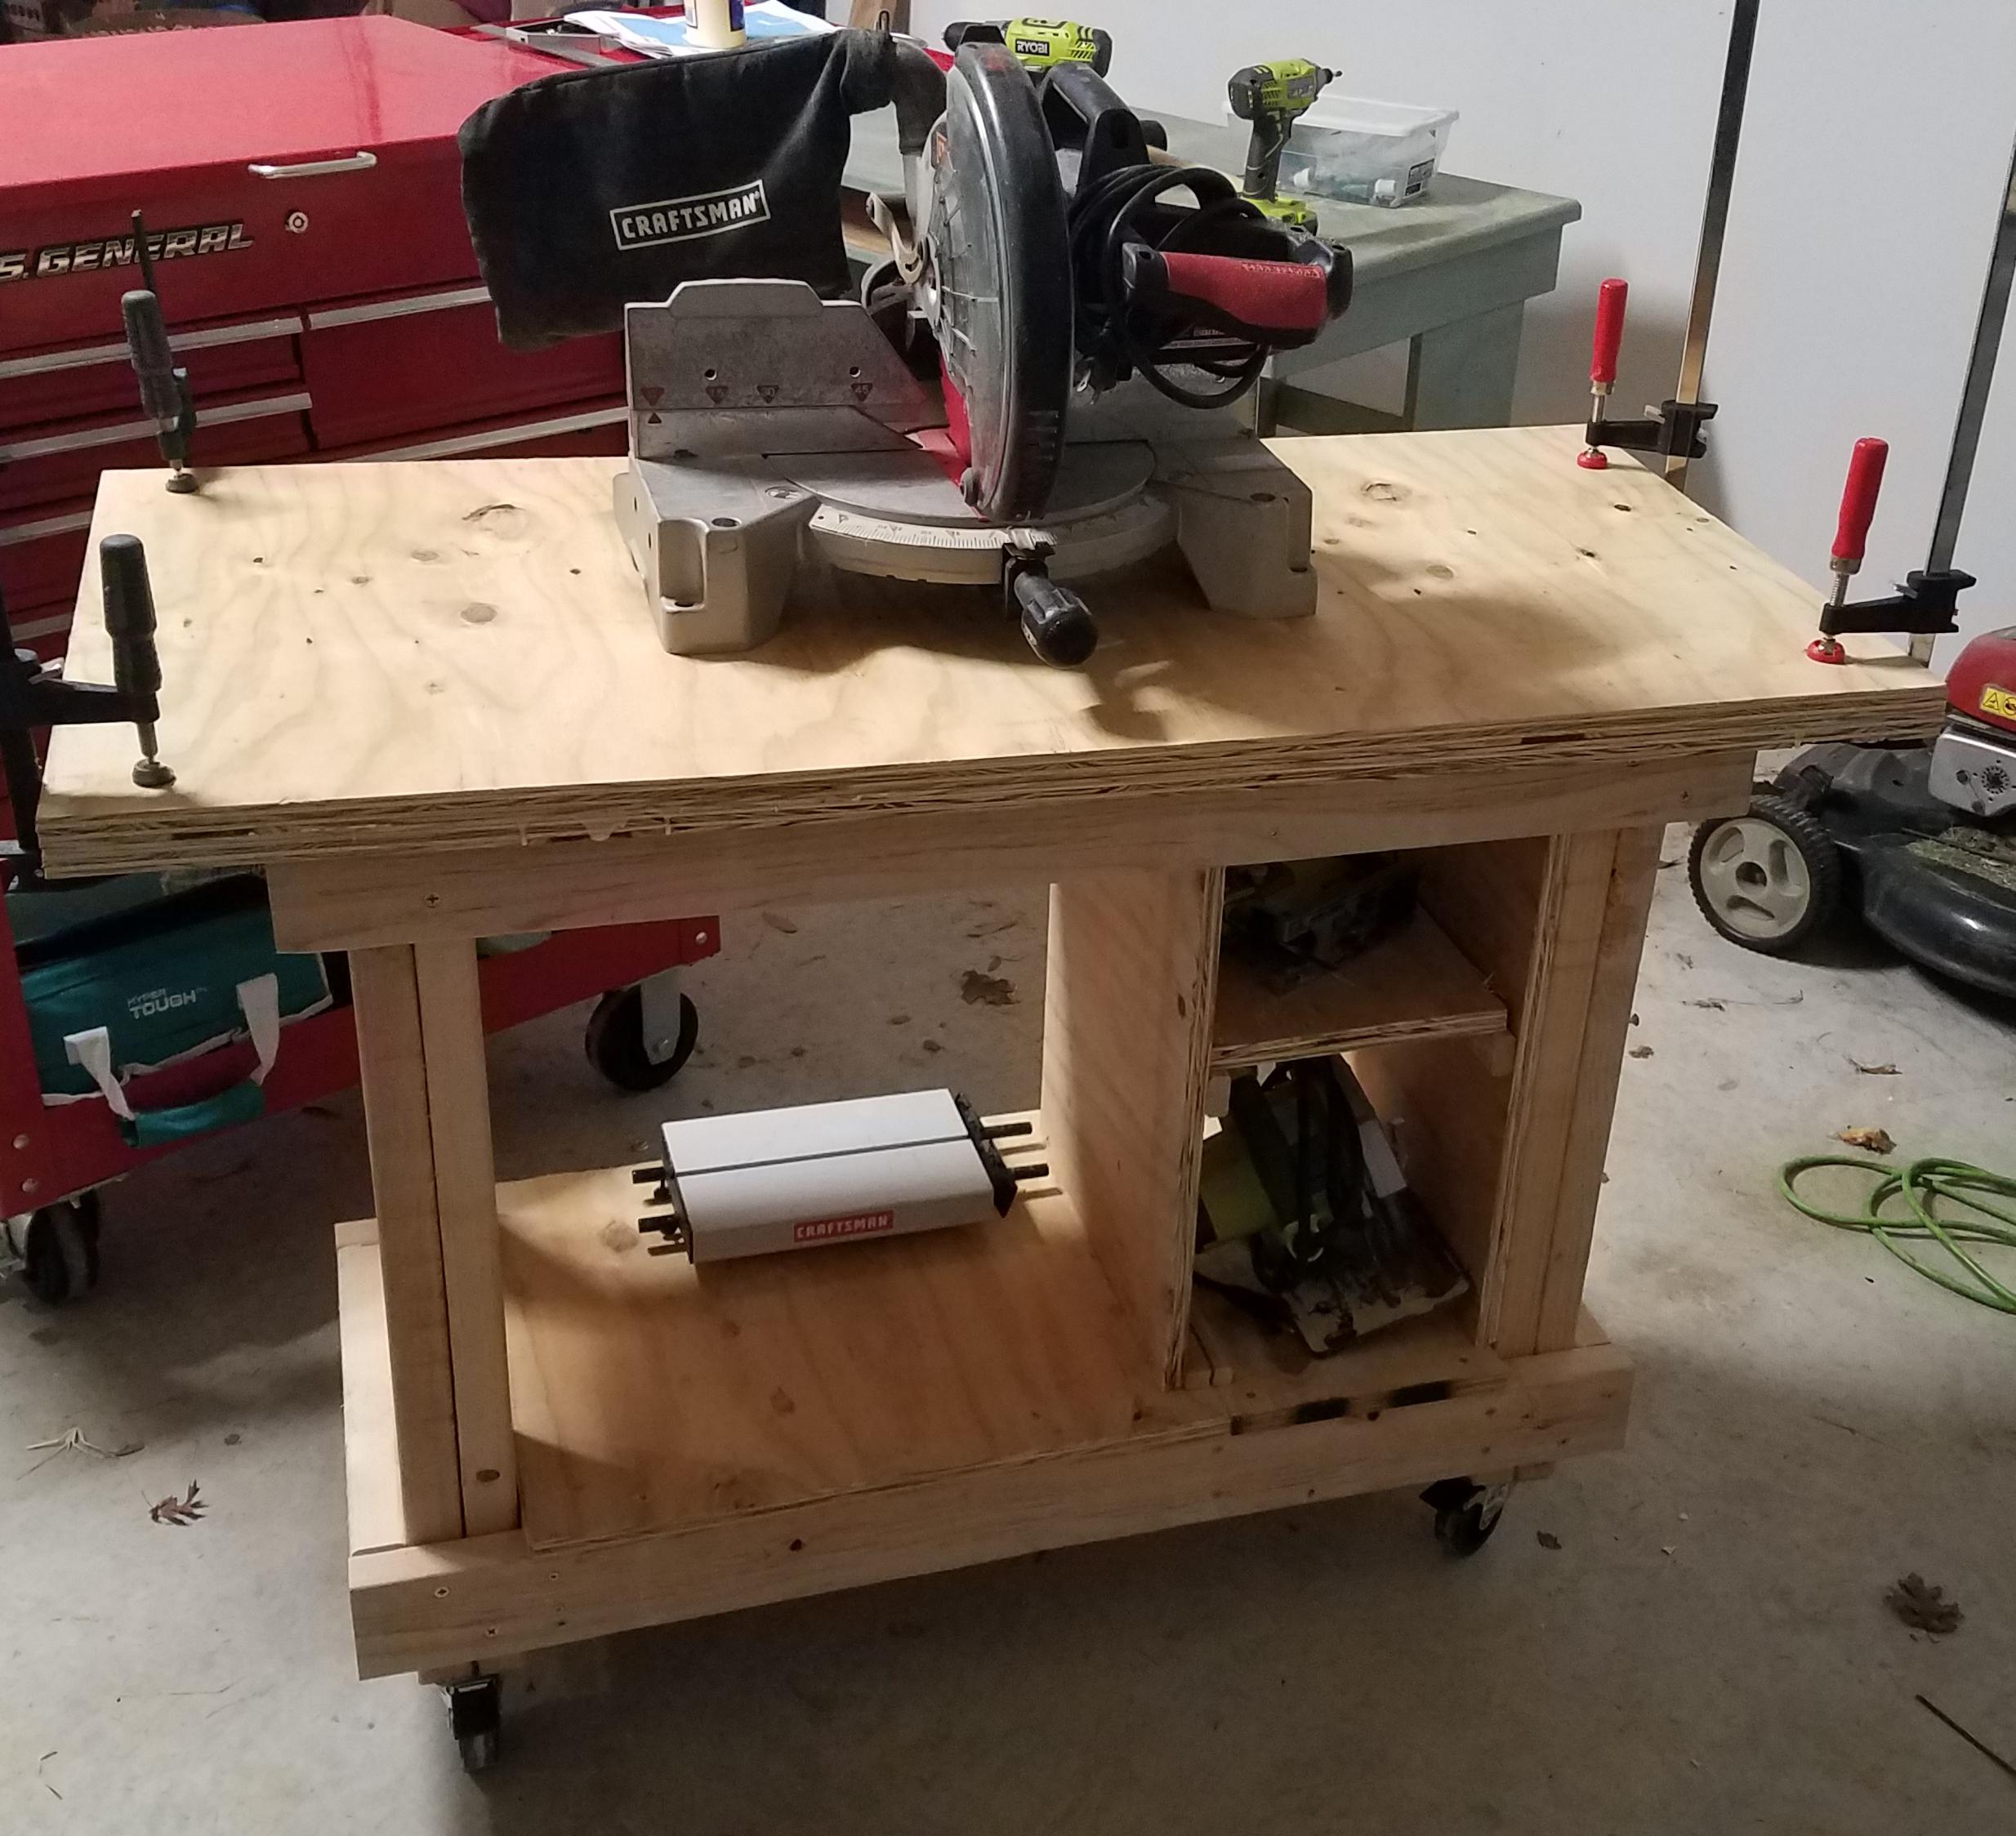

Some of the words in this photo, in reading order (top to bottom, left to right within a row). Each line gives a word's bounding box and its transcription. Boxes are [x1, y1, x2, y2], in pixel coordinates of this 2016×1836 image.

[1016, 40, 1048, 54] RYOBI
[622, 192, 758, 238] CRAFTSMAN
[37, 223, 253, 277] GENERAL
[129, 990, 196, 1019] TOUGH
[796, 1214, 888, 1238] CRAFTSMAN
